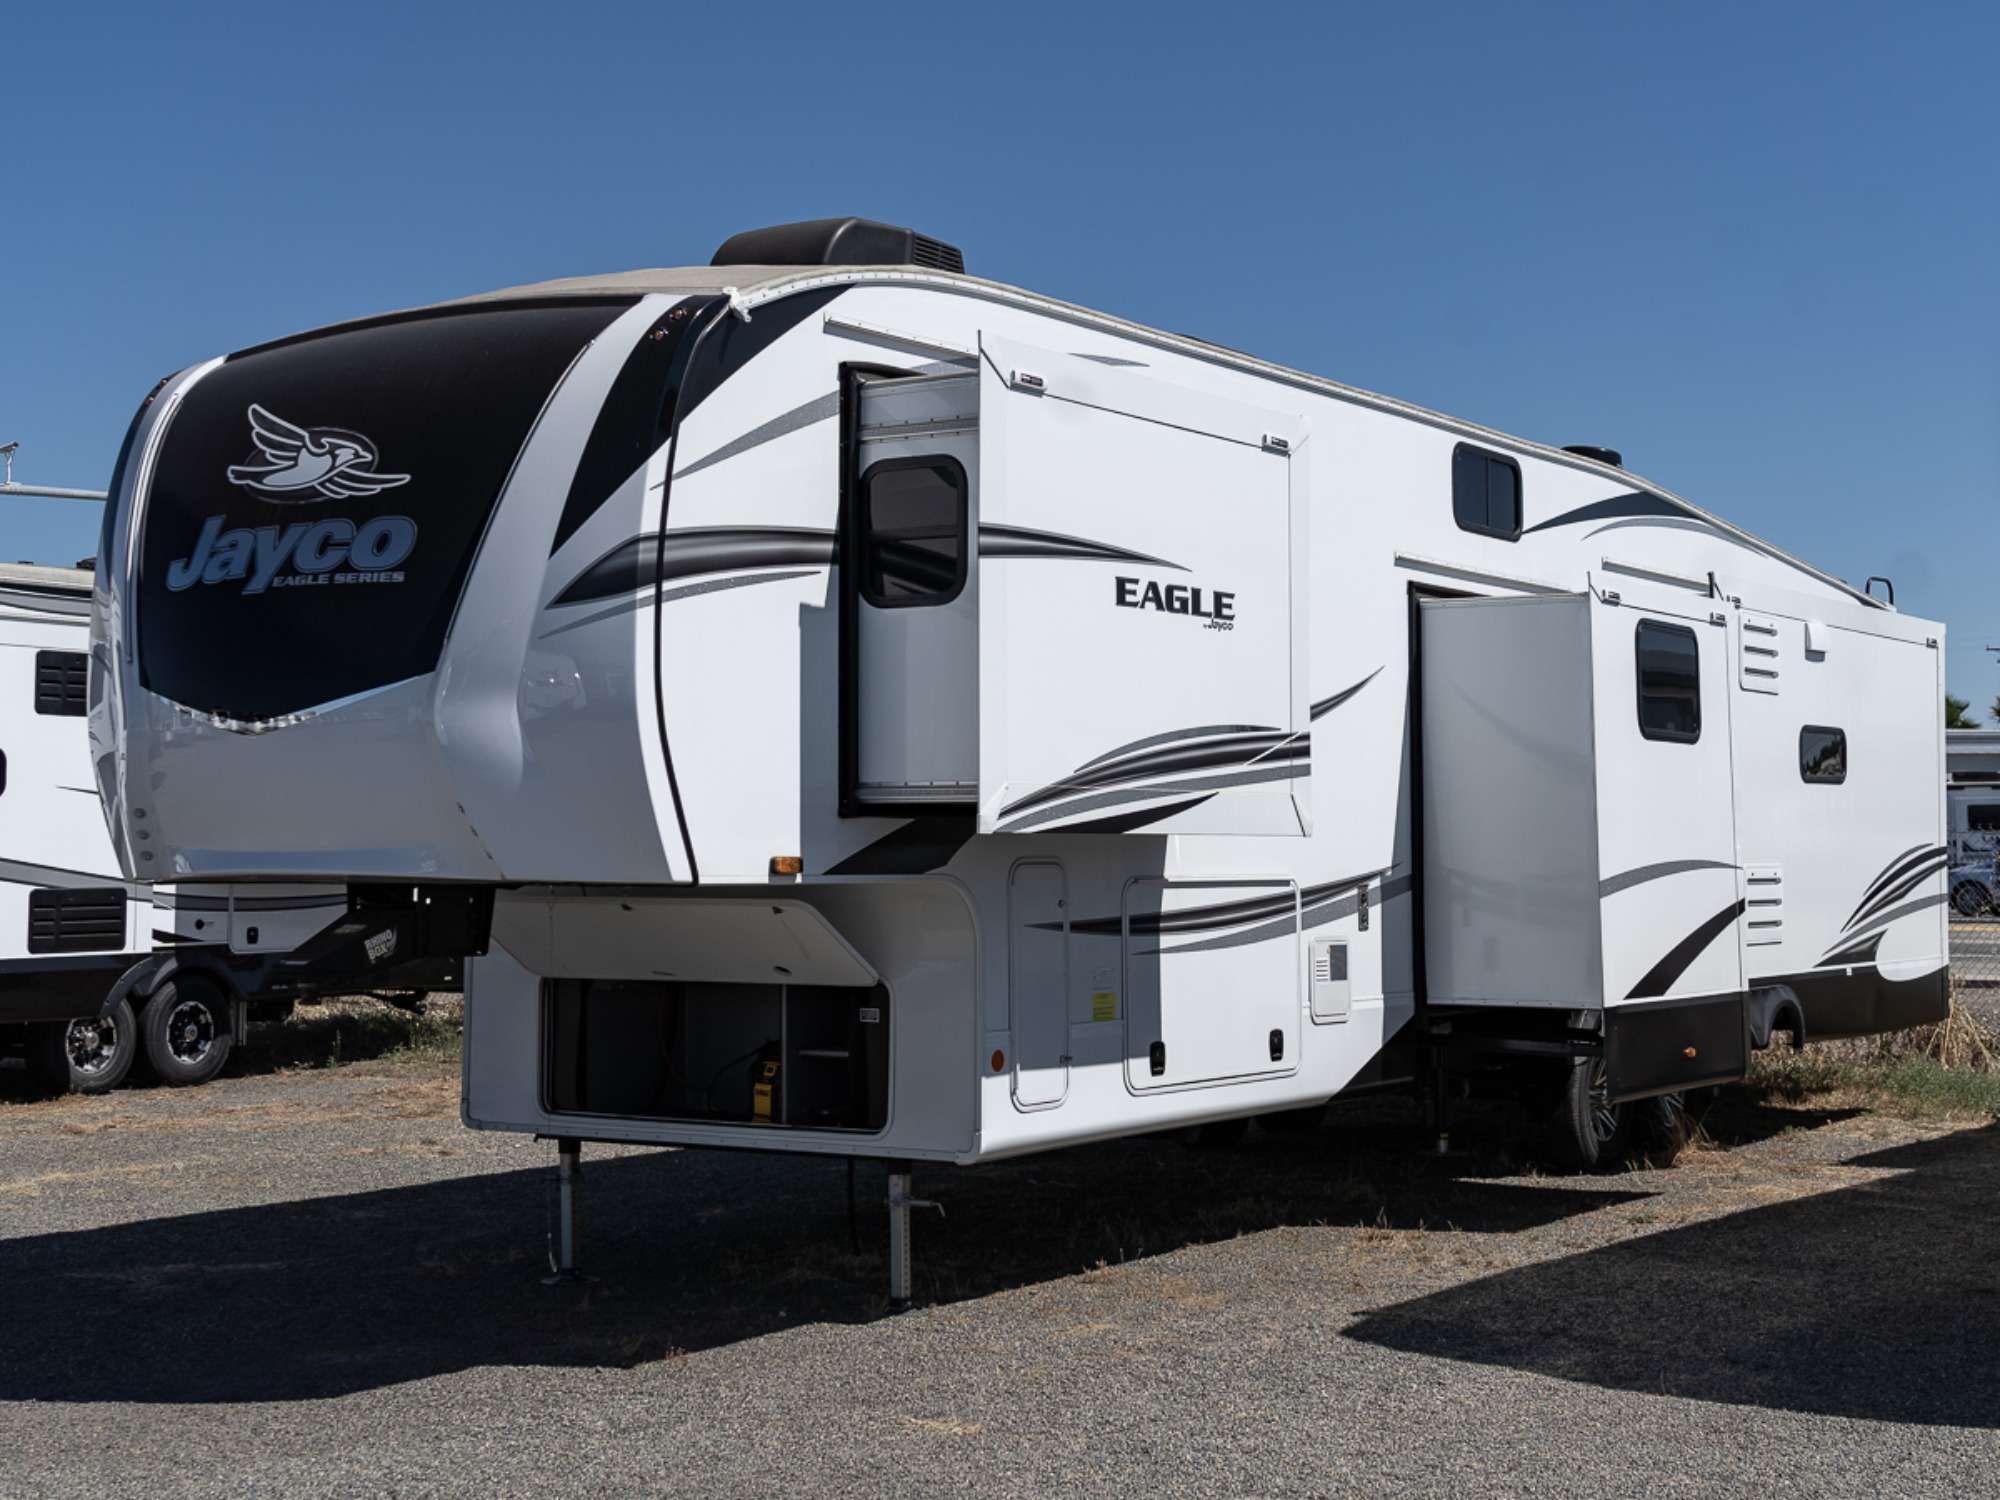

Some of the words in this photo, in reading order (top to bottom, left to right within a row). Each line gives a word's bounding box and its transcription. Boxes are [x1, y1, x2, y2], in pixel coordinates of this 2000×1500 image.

[166, 514, 418, 595] Jayco
[272, 574, 329, 587] EAGLE
[333, 571, 405, 584] SERIES
[1115, 576, 1235, 621] EAGLE
[1207, 618, 1234, 632] Jayco
[364, 929, 393, 950] RHINO
[368, 944, 389, 960] BOX
